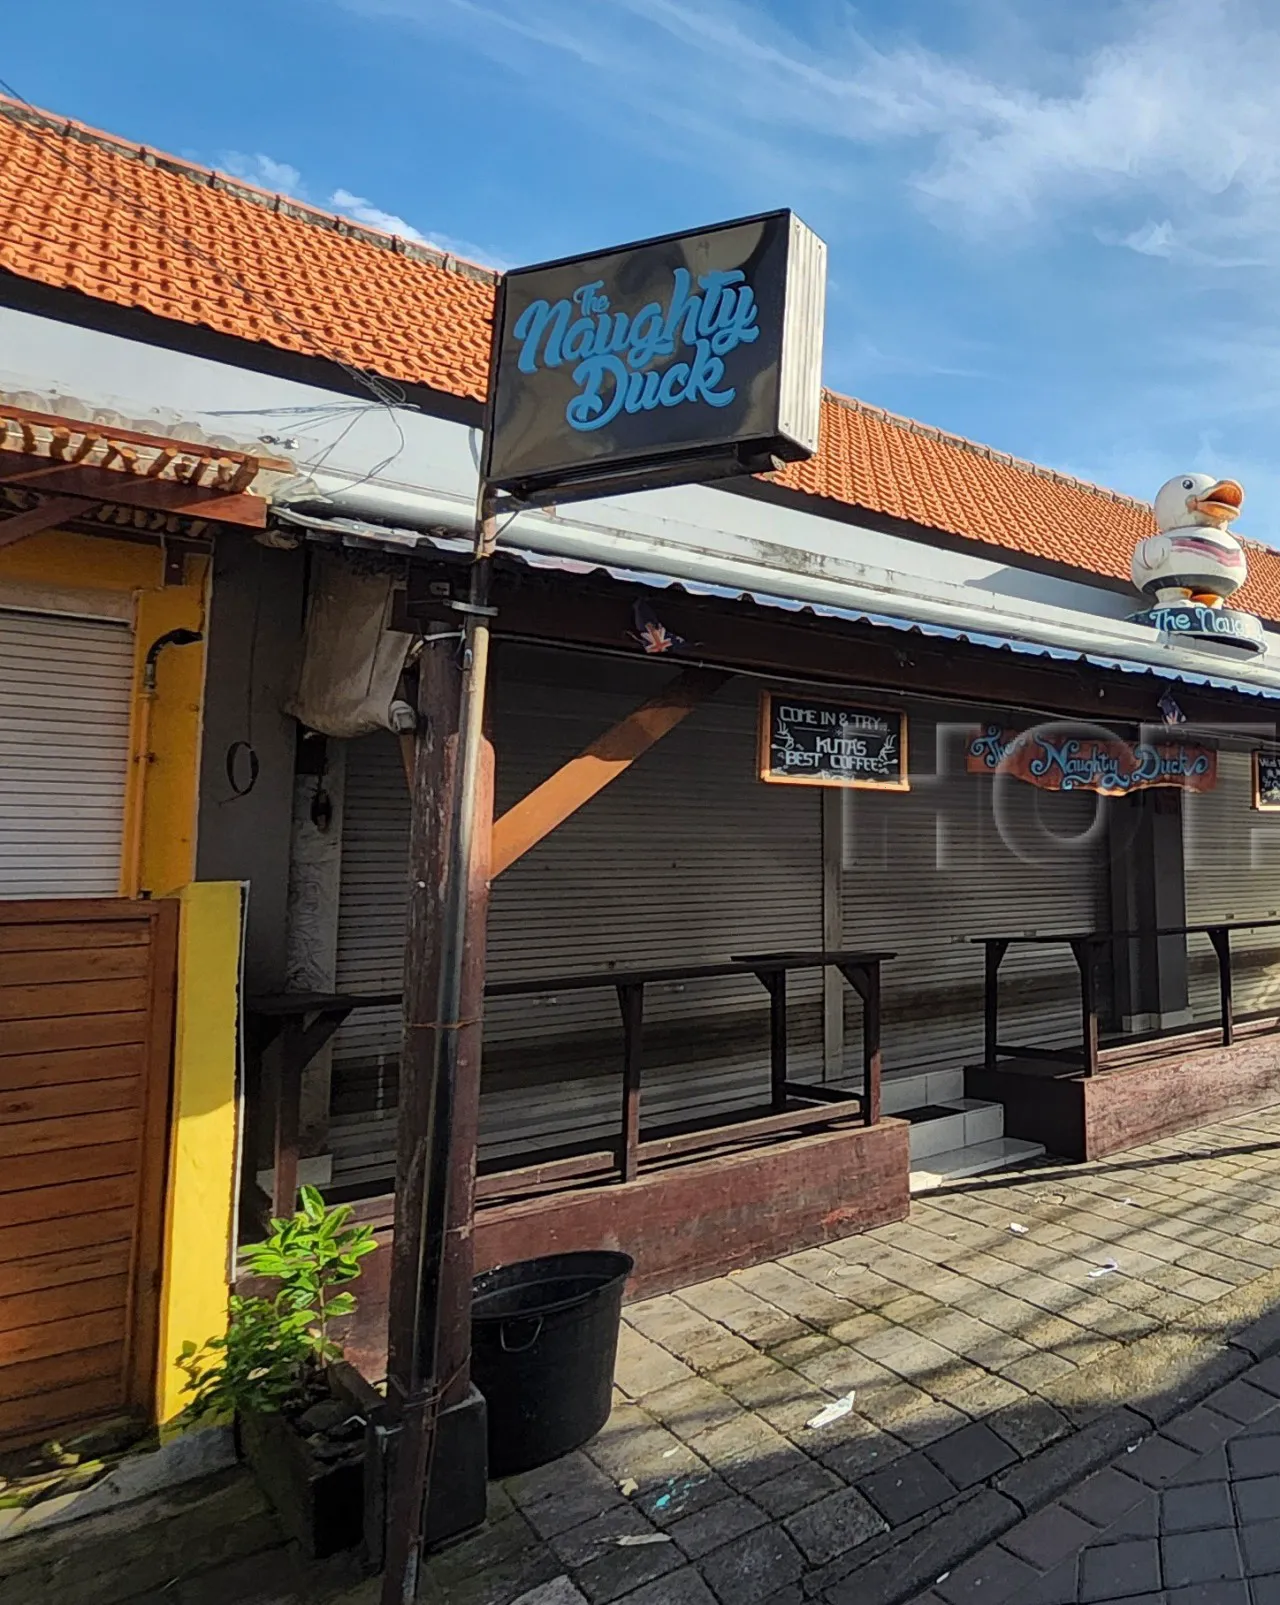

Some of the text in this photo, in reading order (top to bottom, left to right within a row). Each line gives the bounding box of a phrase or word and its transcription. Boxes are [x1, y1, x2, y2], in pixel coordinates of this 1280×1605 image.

[573, 280, 611, 317] The
[513, 267, 760, 374] Naughty
[565, 340, 736, 432] Duck
[1149, 608, 1191, 632] The
[780, 706, 817, 725] COME
[820, 711, 836, 726] IN
[839, 712, 849, 727] &
[785, 750, 880, 772] BEST COFFEE
[1031, 732, 1131, 791] Naughty
[1131, 743, 1209, 782] Duck
